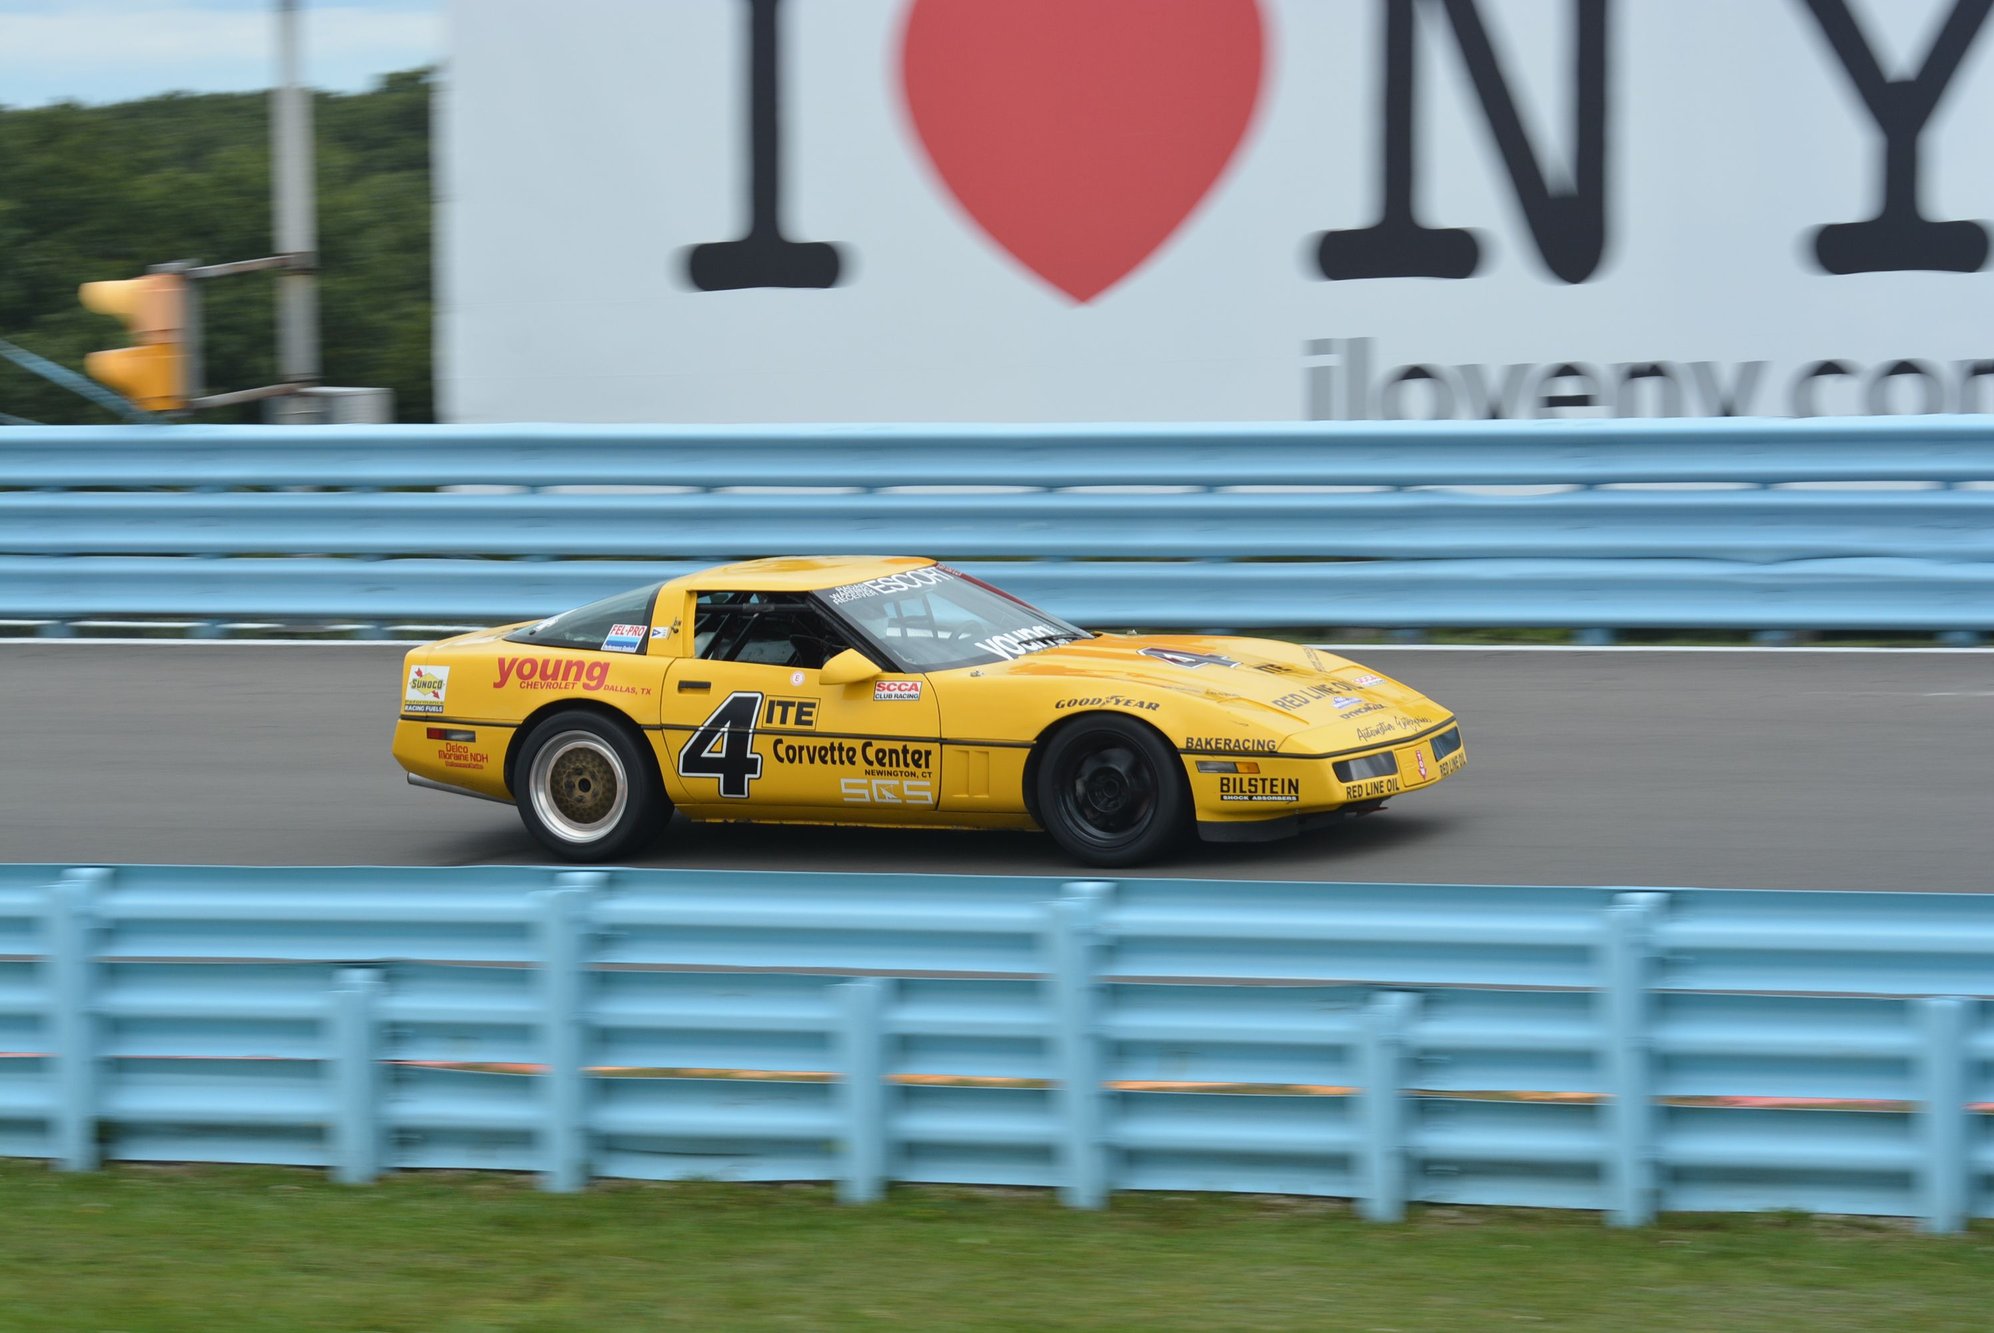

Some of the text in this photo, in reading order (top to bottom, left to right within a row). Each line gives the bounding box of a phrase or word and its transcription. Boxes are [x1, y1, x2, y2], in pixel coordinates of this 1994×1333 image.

[1302, 336, 1994, 420] ilovenyco
[865, 567, 953, 594] ESCORT
[493, 657, 610, 691] young
[411, 679, 443, 690] SUNOCO
[519, 681, 578, 690] CHEVROLET
[603, 684, 638, 694] DALLAS,
[876, 682, 919, 692] SCCA
[1272, 693, 1311, 711] RED
[1307, 683, 1341, 700] LINE
[1331, 678, 1364, 694] OIL
[765, 700, 817, 727] ITE
[445, 742, 469, 753] Delco
[678, 691, 763, 798] 4
[1185, 737, 1277, 751] BAKERACING
[470, 754, 489, 763] NDH
[773, 738, 933, 769] Corvette Center
[864, 769, 919, 779] NEWINGTON,
[1440, 764, 1450, 777] RED
[1220, 777, 1299, 794] BILSTEIN
[1346, 778, 1400, 799] RED LINE OIL
